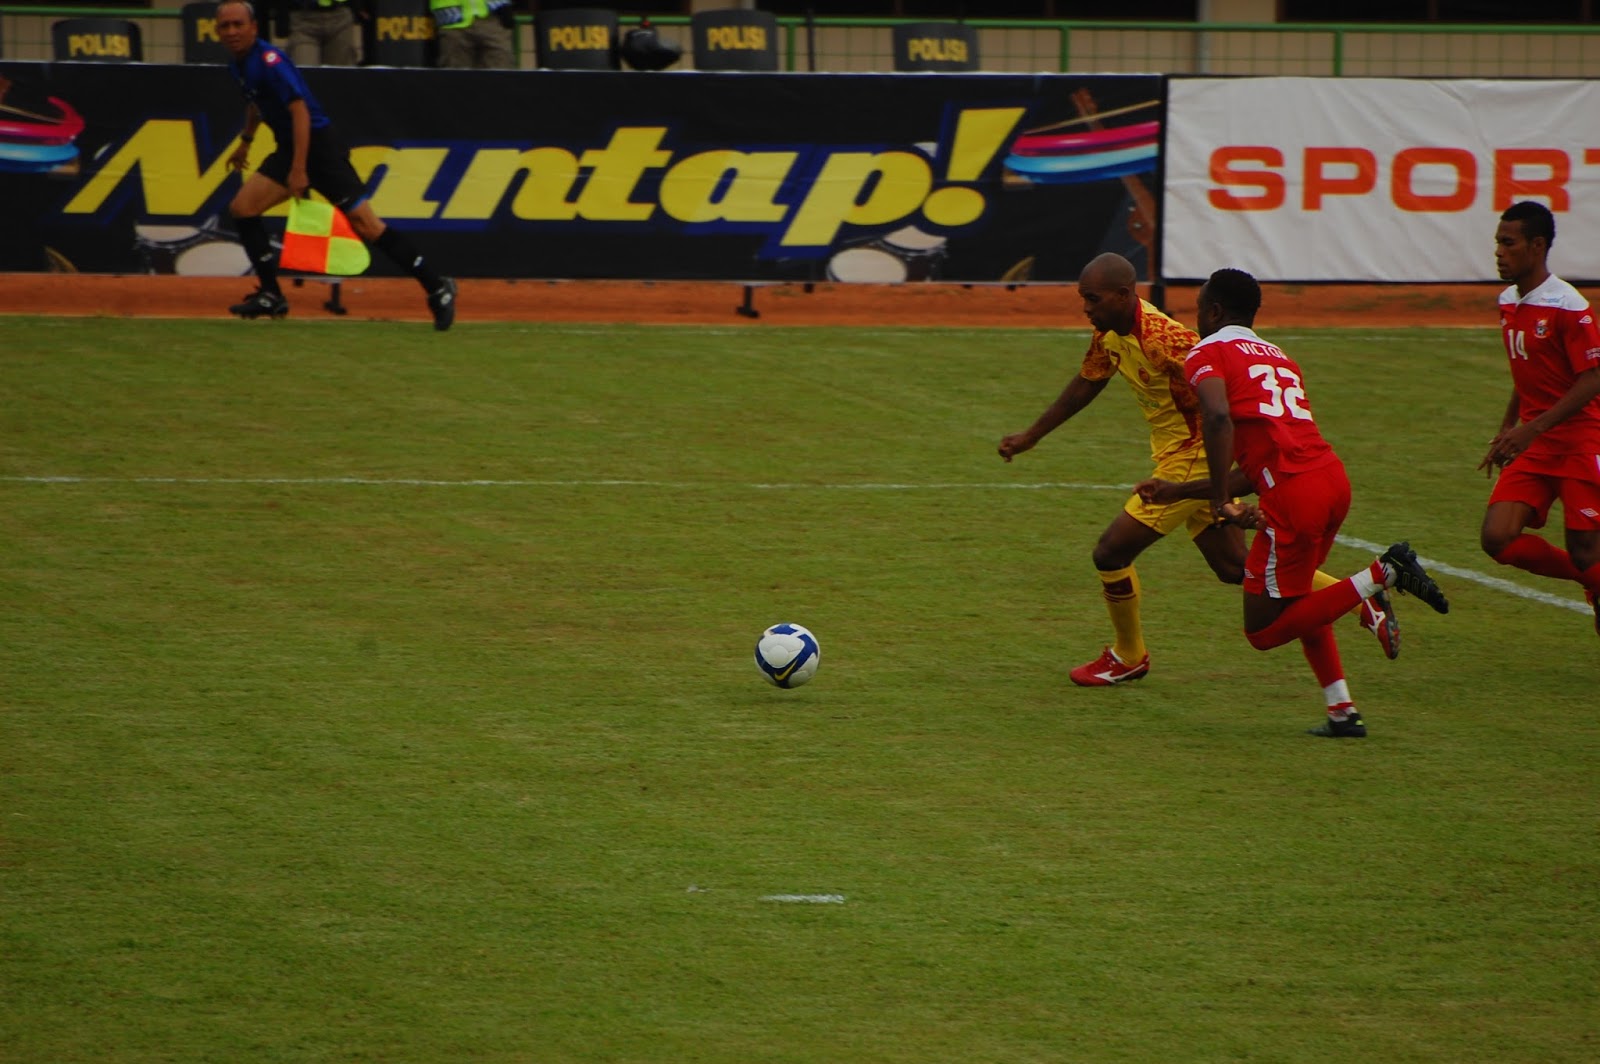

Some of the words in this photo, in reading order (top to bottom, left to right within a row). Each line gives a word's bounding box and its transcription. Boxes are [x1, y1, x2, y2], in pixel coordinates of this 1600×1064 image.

[68, 34, 131, 58] POLISI
[549, 26, 609, 51] POLISI
[707, 26, 767, 51] POLISI
[908, 38, 968, 62] POLISI
[1207, 145, 1600, 213] SPOR
[1508, 329, 1528, 361] 14
[1248, 364, 1313, 422] 32
